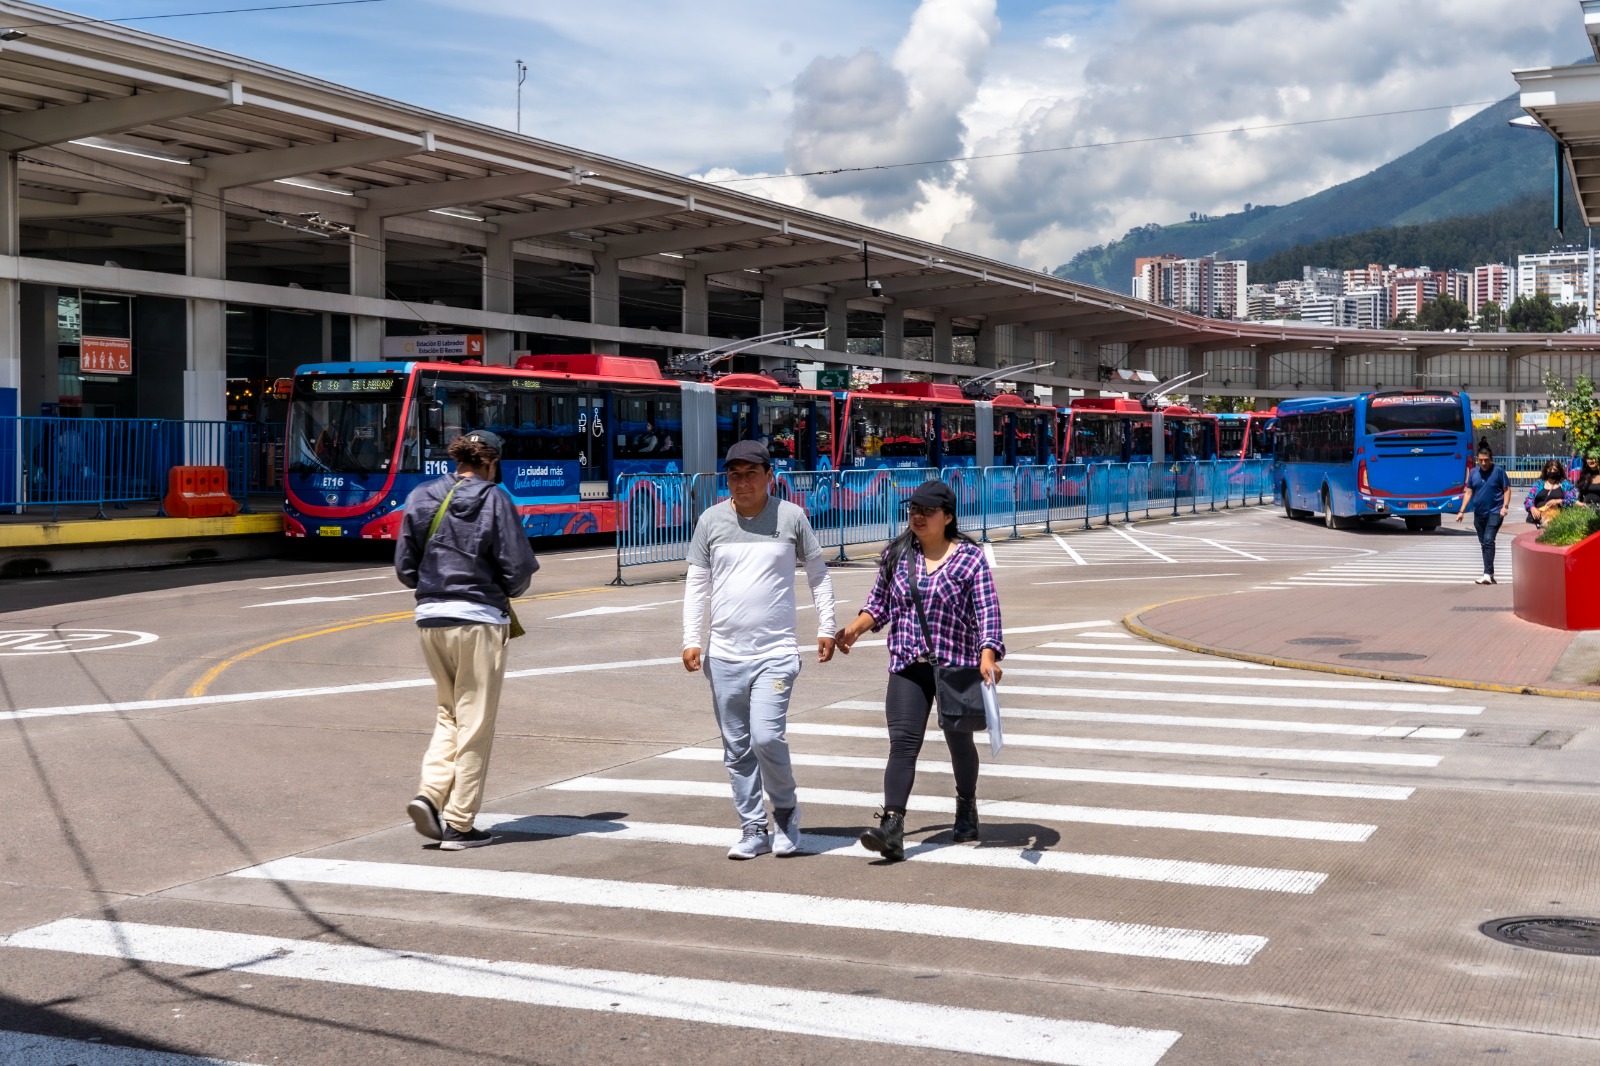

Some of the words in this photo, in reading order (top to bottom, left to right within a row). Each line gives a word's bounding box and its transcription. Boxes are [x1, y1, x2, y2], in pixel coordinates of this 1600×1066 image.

[404, 342, 414, 352] C1
[442, 339, 465, 347] Labrador
[425, 460, 448, 475] ET16
[517, 466, 526, 477] La
[526, 465, 549, 476] ciudad
[549, 465, 564, 476] más
[323, 477, 344, 487] ET16
[531, 477, 542, 487] del
[542, 477, 565, 487] mundo
